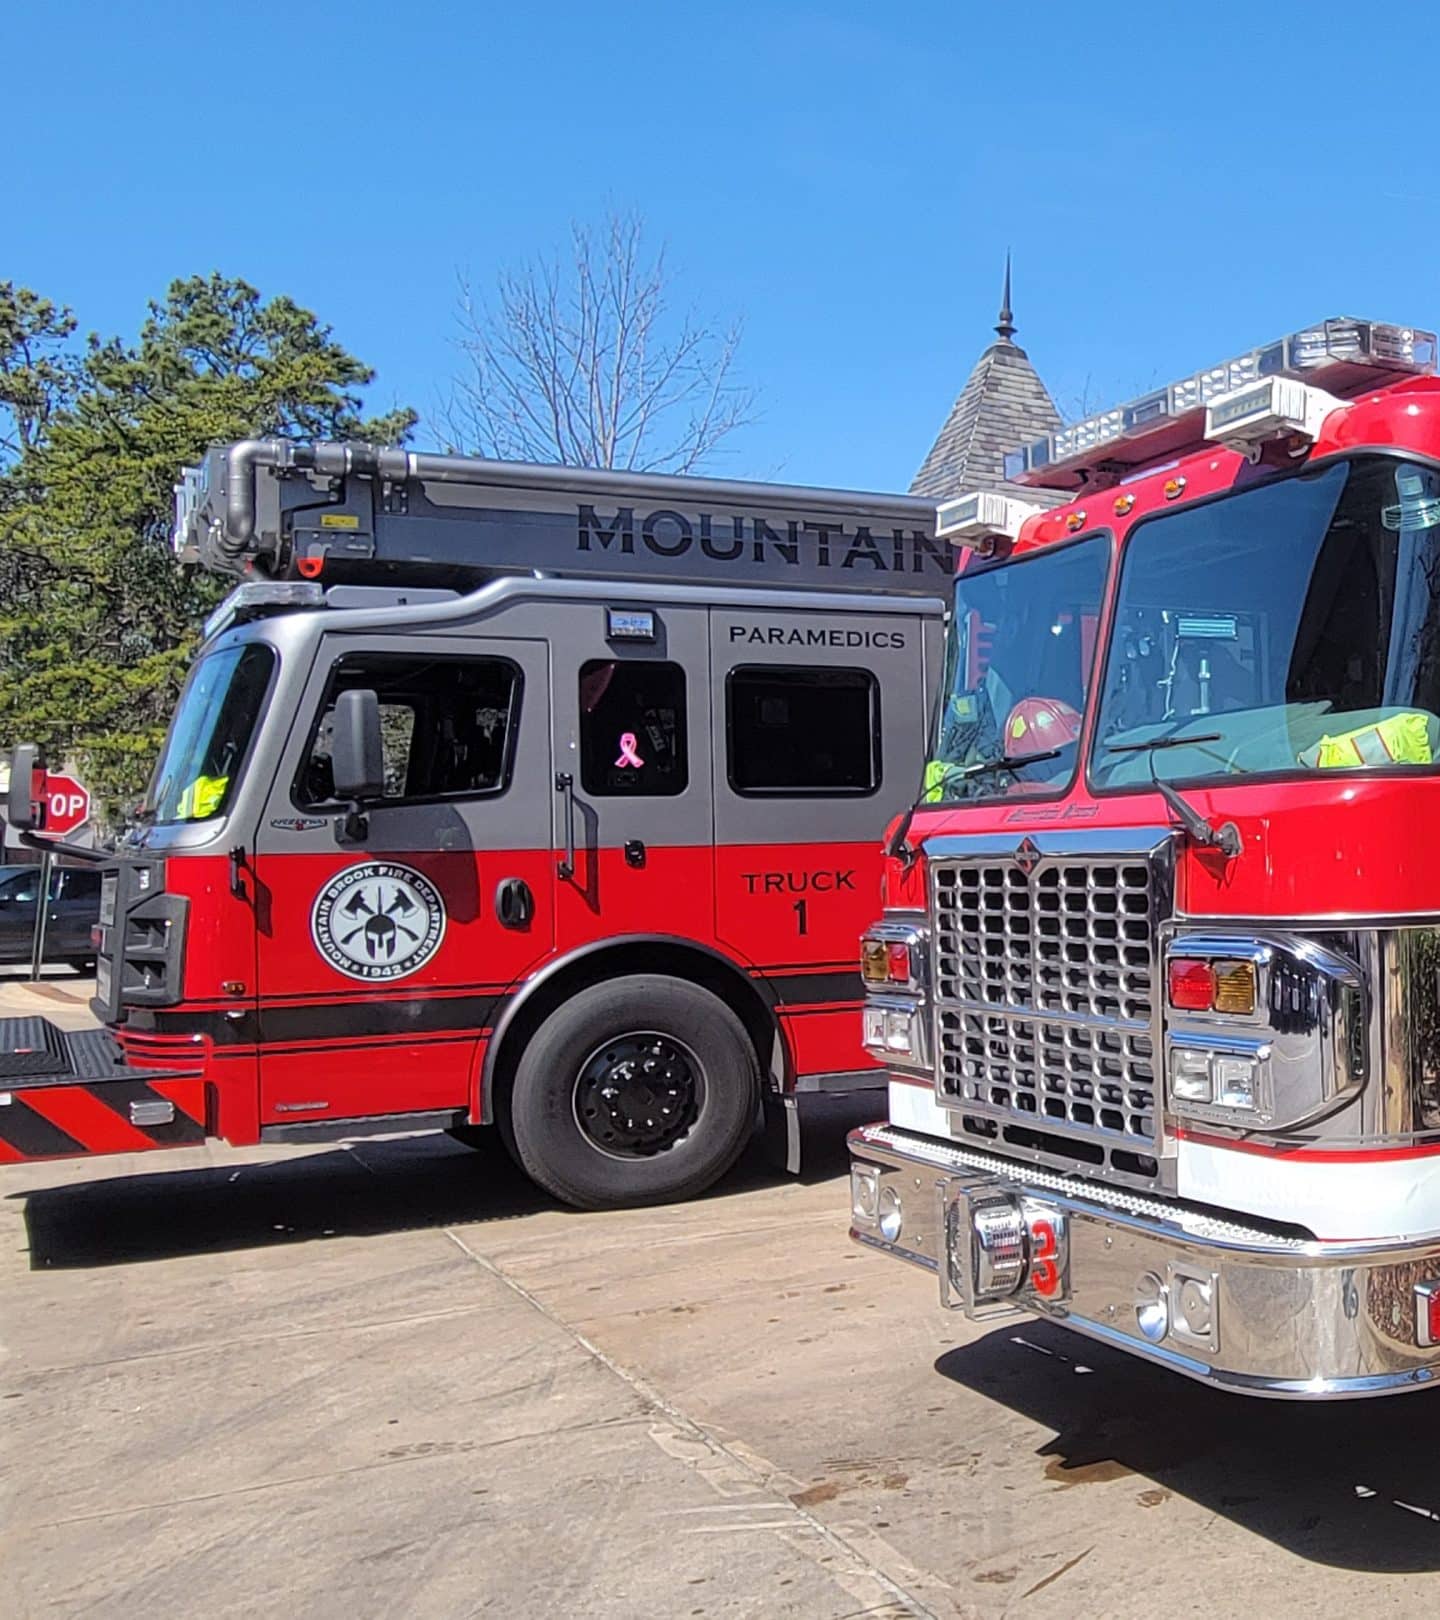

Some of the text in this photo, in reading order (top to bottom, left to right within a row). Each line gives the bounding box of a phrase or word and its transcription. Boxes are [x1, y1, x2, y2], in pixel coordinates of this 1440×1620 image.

[576, 503, 956, 576] MOUNTAIN
[729, 626, 905, 649] PARAMEDICS
[47, 793, 84, 817] OP
[740, 869, 857, 895] TRUCK
[318, 866, 441, 970] MOUNTAIN BROOK FIRE DEPARTMENT
[792, 898, 808, 936] 1
[361, 963, 403, 978] 1942
[1031, 1219, 1058, 1297] 3
